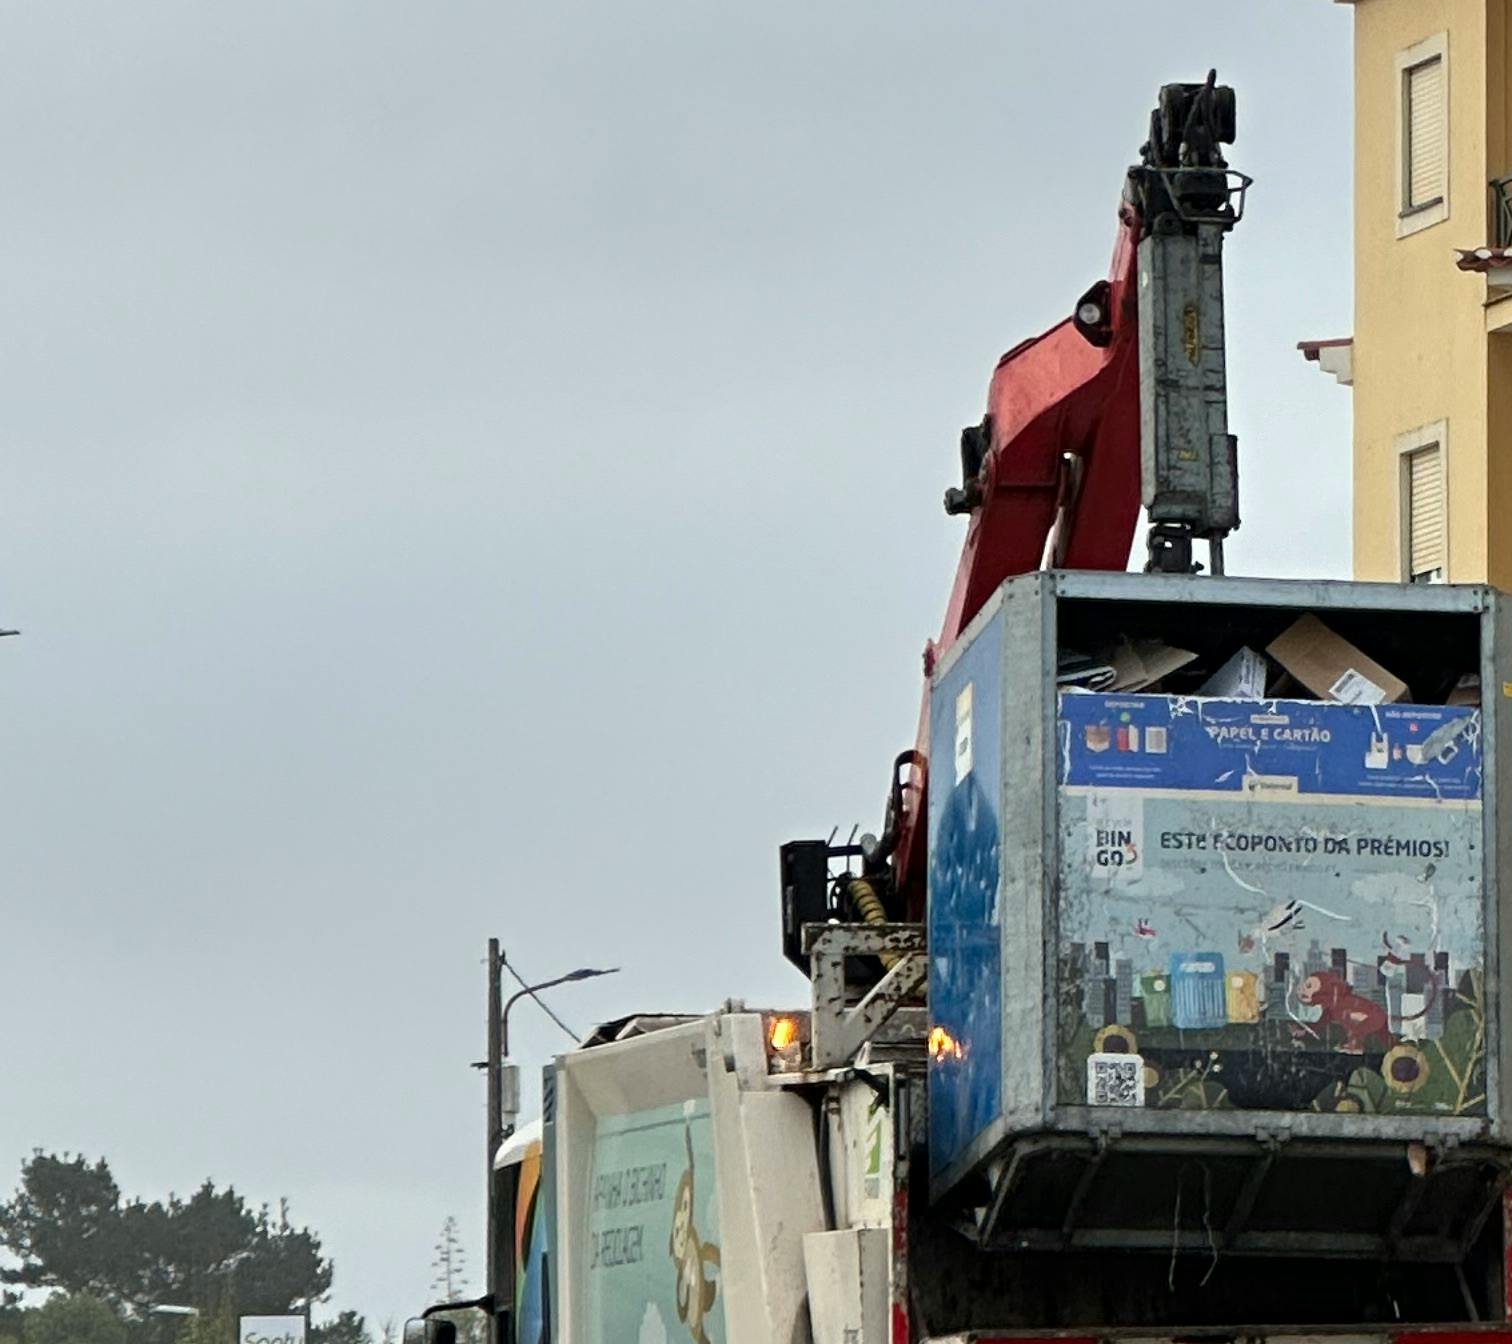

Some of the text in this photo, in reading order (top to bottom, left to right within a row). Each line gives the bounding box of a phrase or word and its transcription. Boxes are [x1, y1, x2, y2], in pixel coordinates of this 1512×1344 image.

[1210, 726, 1331, 743] PAPEL E CARTÃO
[1160, 831, 1206, 850] ESTE
[1213, 832, 1318, 854] ECOPONTO
[1356, 835, 1450, 858] PRÉMIOS!
